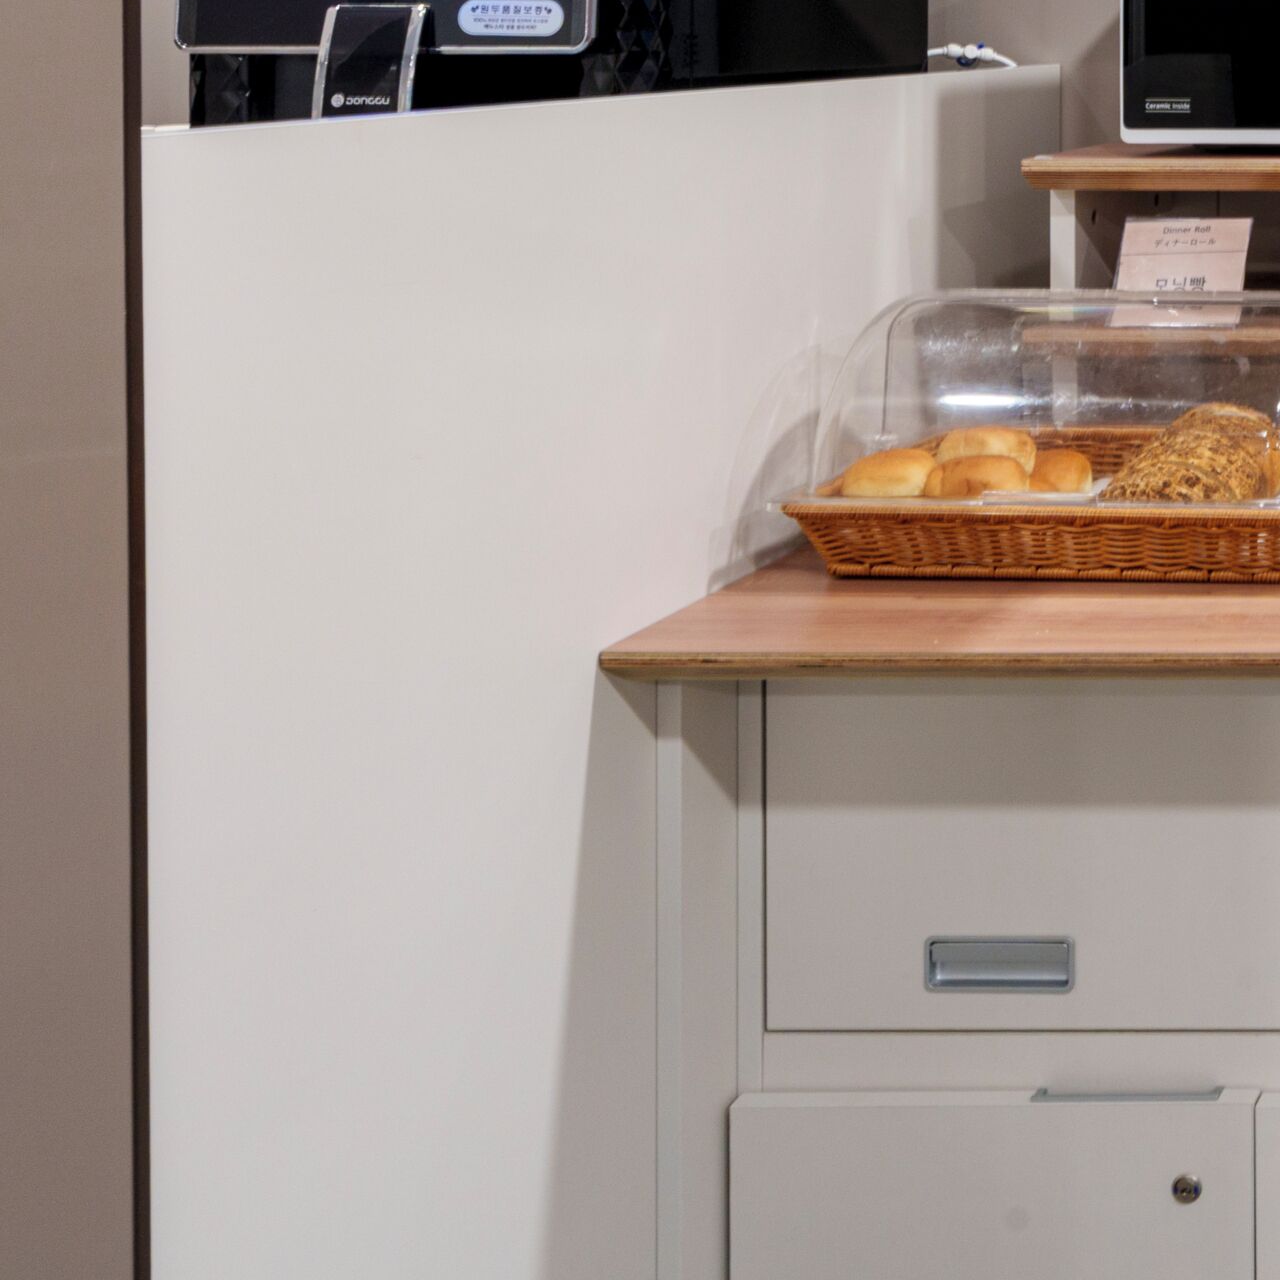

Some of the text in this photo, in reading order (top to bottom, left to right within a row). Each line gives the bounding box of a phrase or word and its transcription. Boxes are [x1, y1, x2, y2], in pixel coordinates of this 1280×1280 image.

[1145, 101, 1190, 110] Ceramic Inside
[1162, 225, 1211, 235] Dinner Roll
